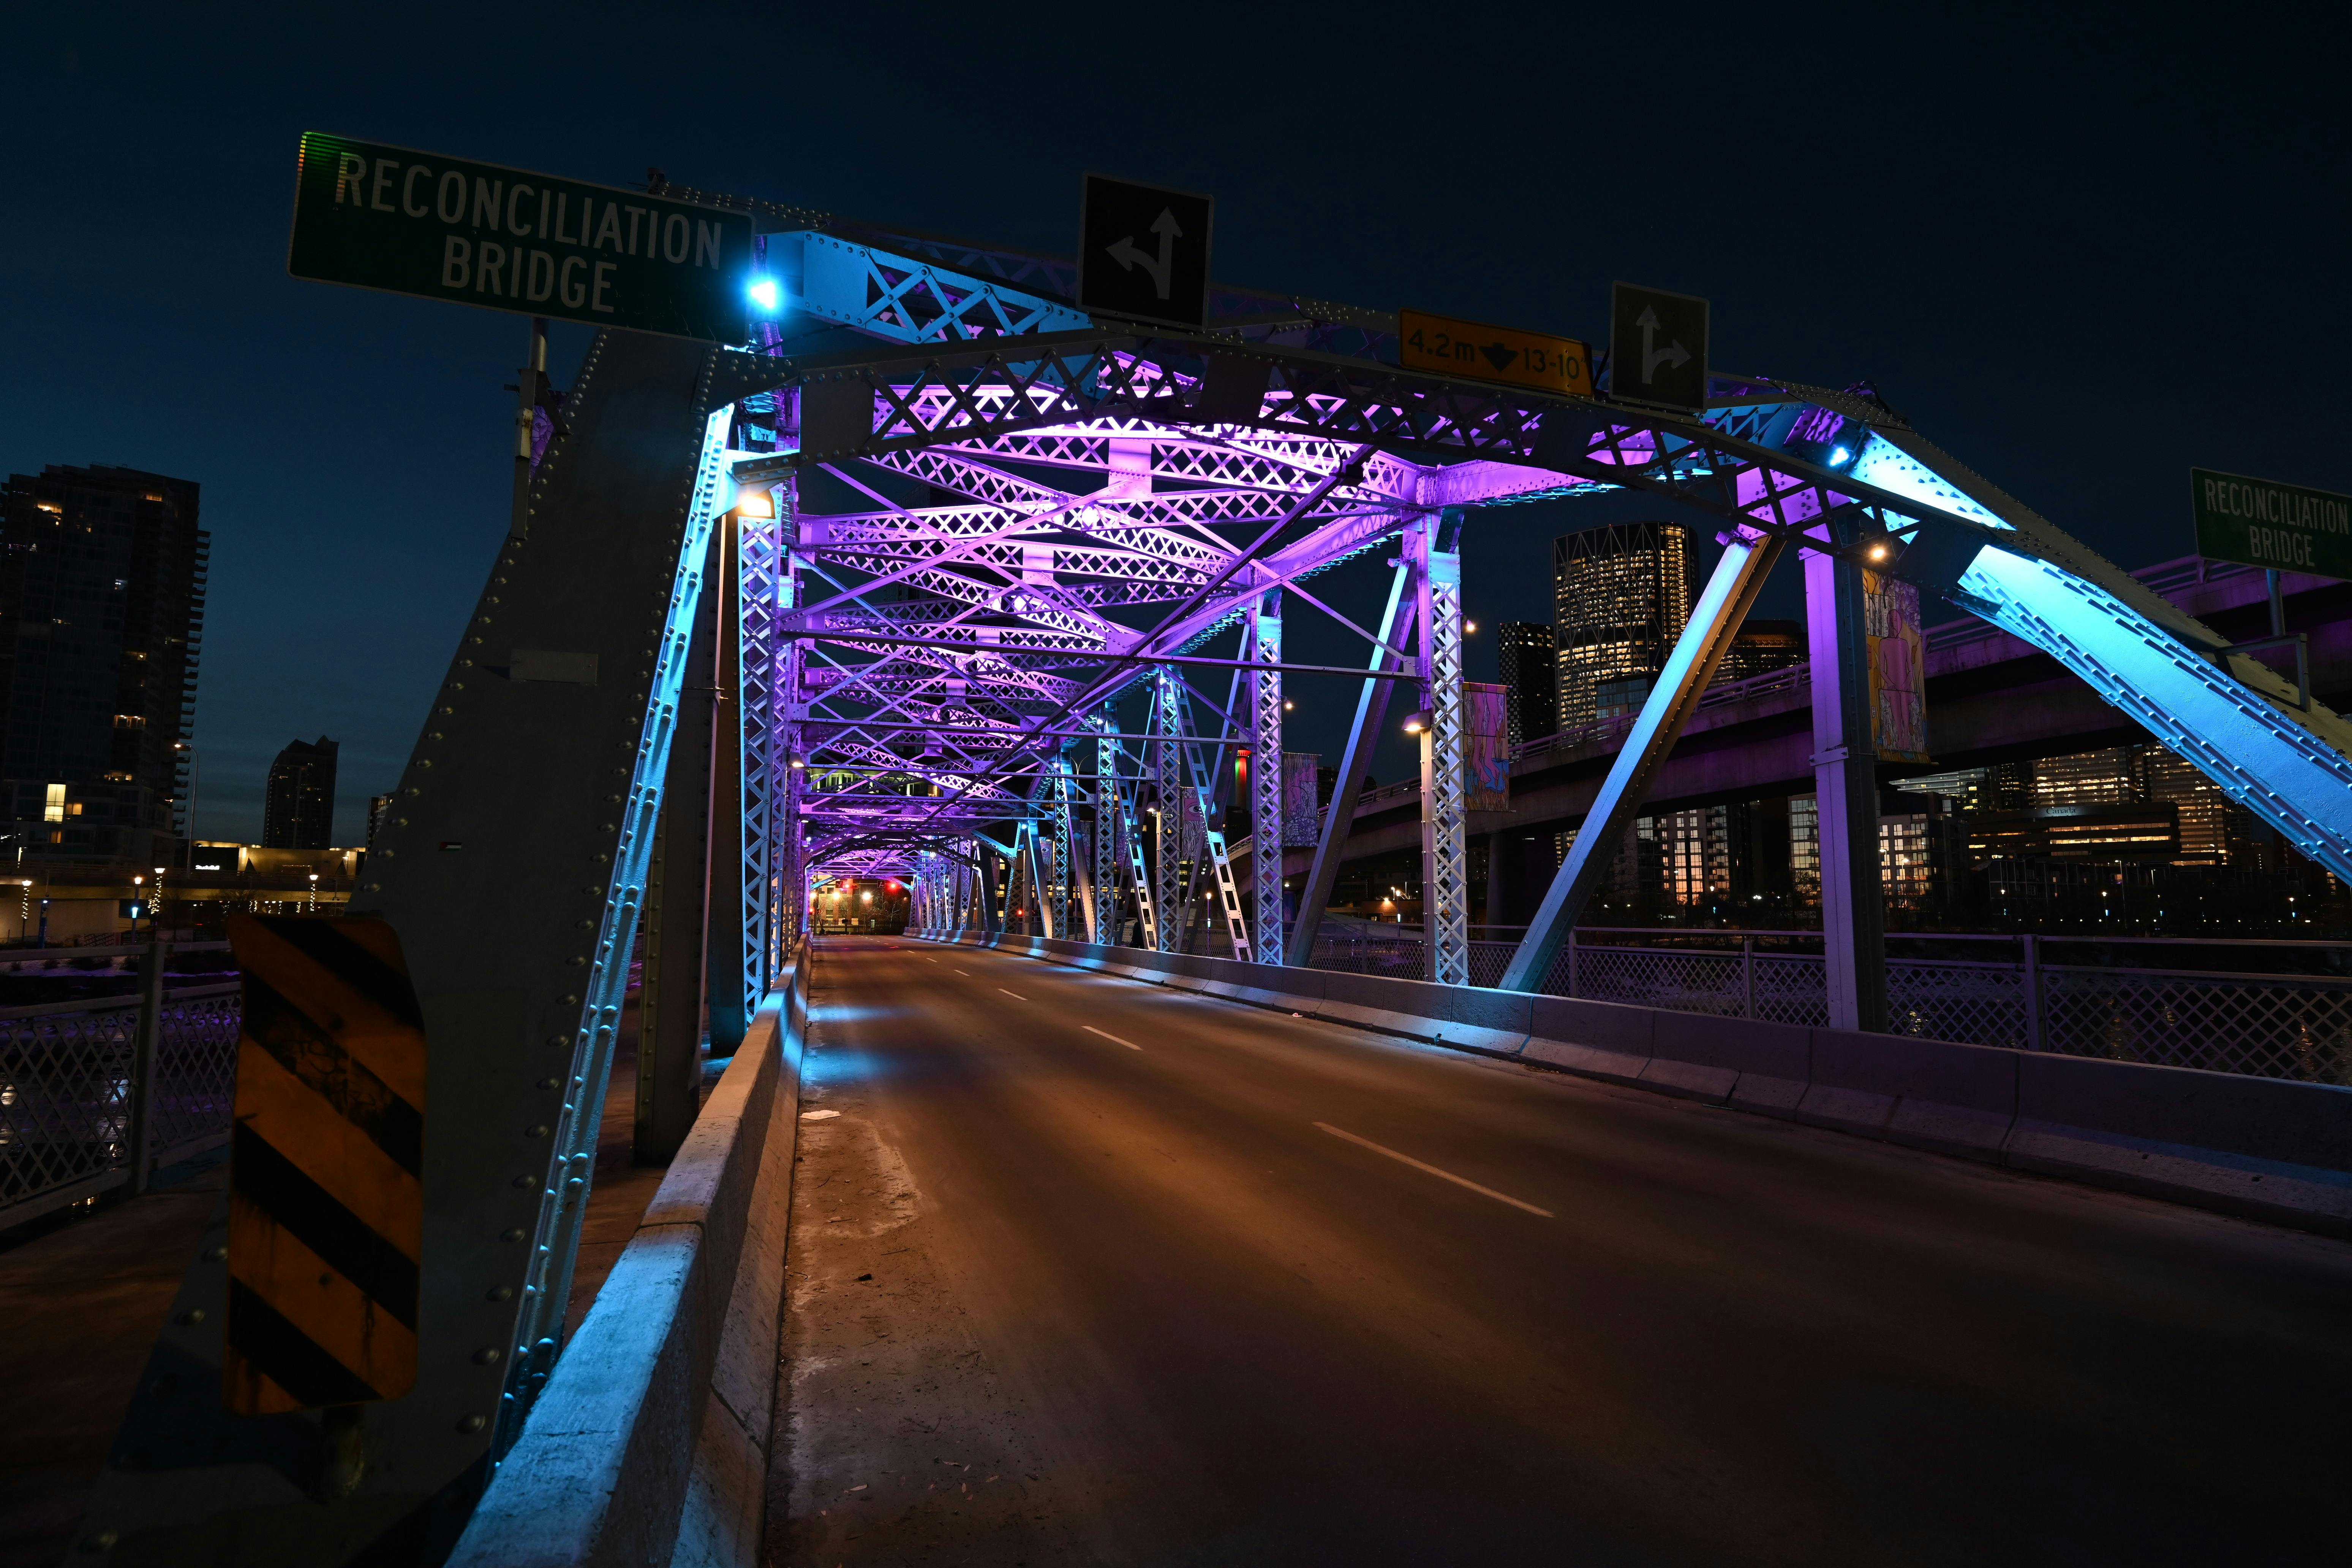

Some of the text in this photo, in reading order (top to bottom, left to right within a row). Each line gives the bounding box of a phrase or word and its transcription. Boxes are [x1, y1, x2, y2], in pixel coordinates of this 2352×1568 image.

[335, 151, 722, 271] RECONCILIATION
[441, 234, 618, 313] BRIDGE
[2205, 479, 2349, 535] RECONCILIATION
[2249, 525, 2315, 566] BRIDGE
